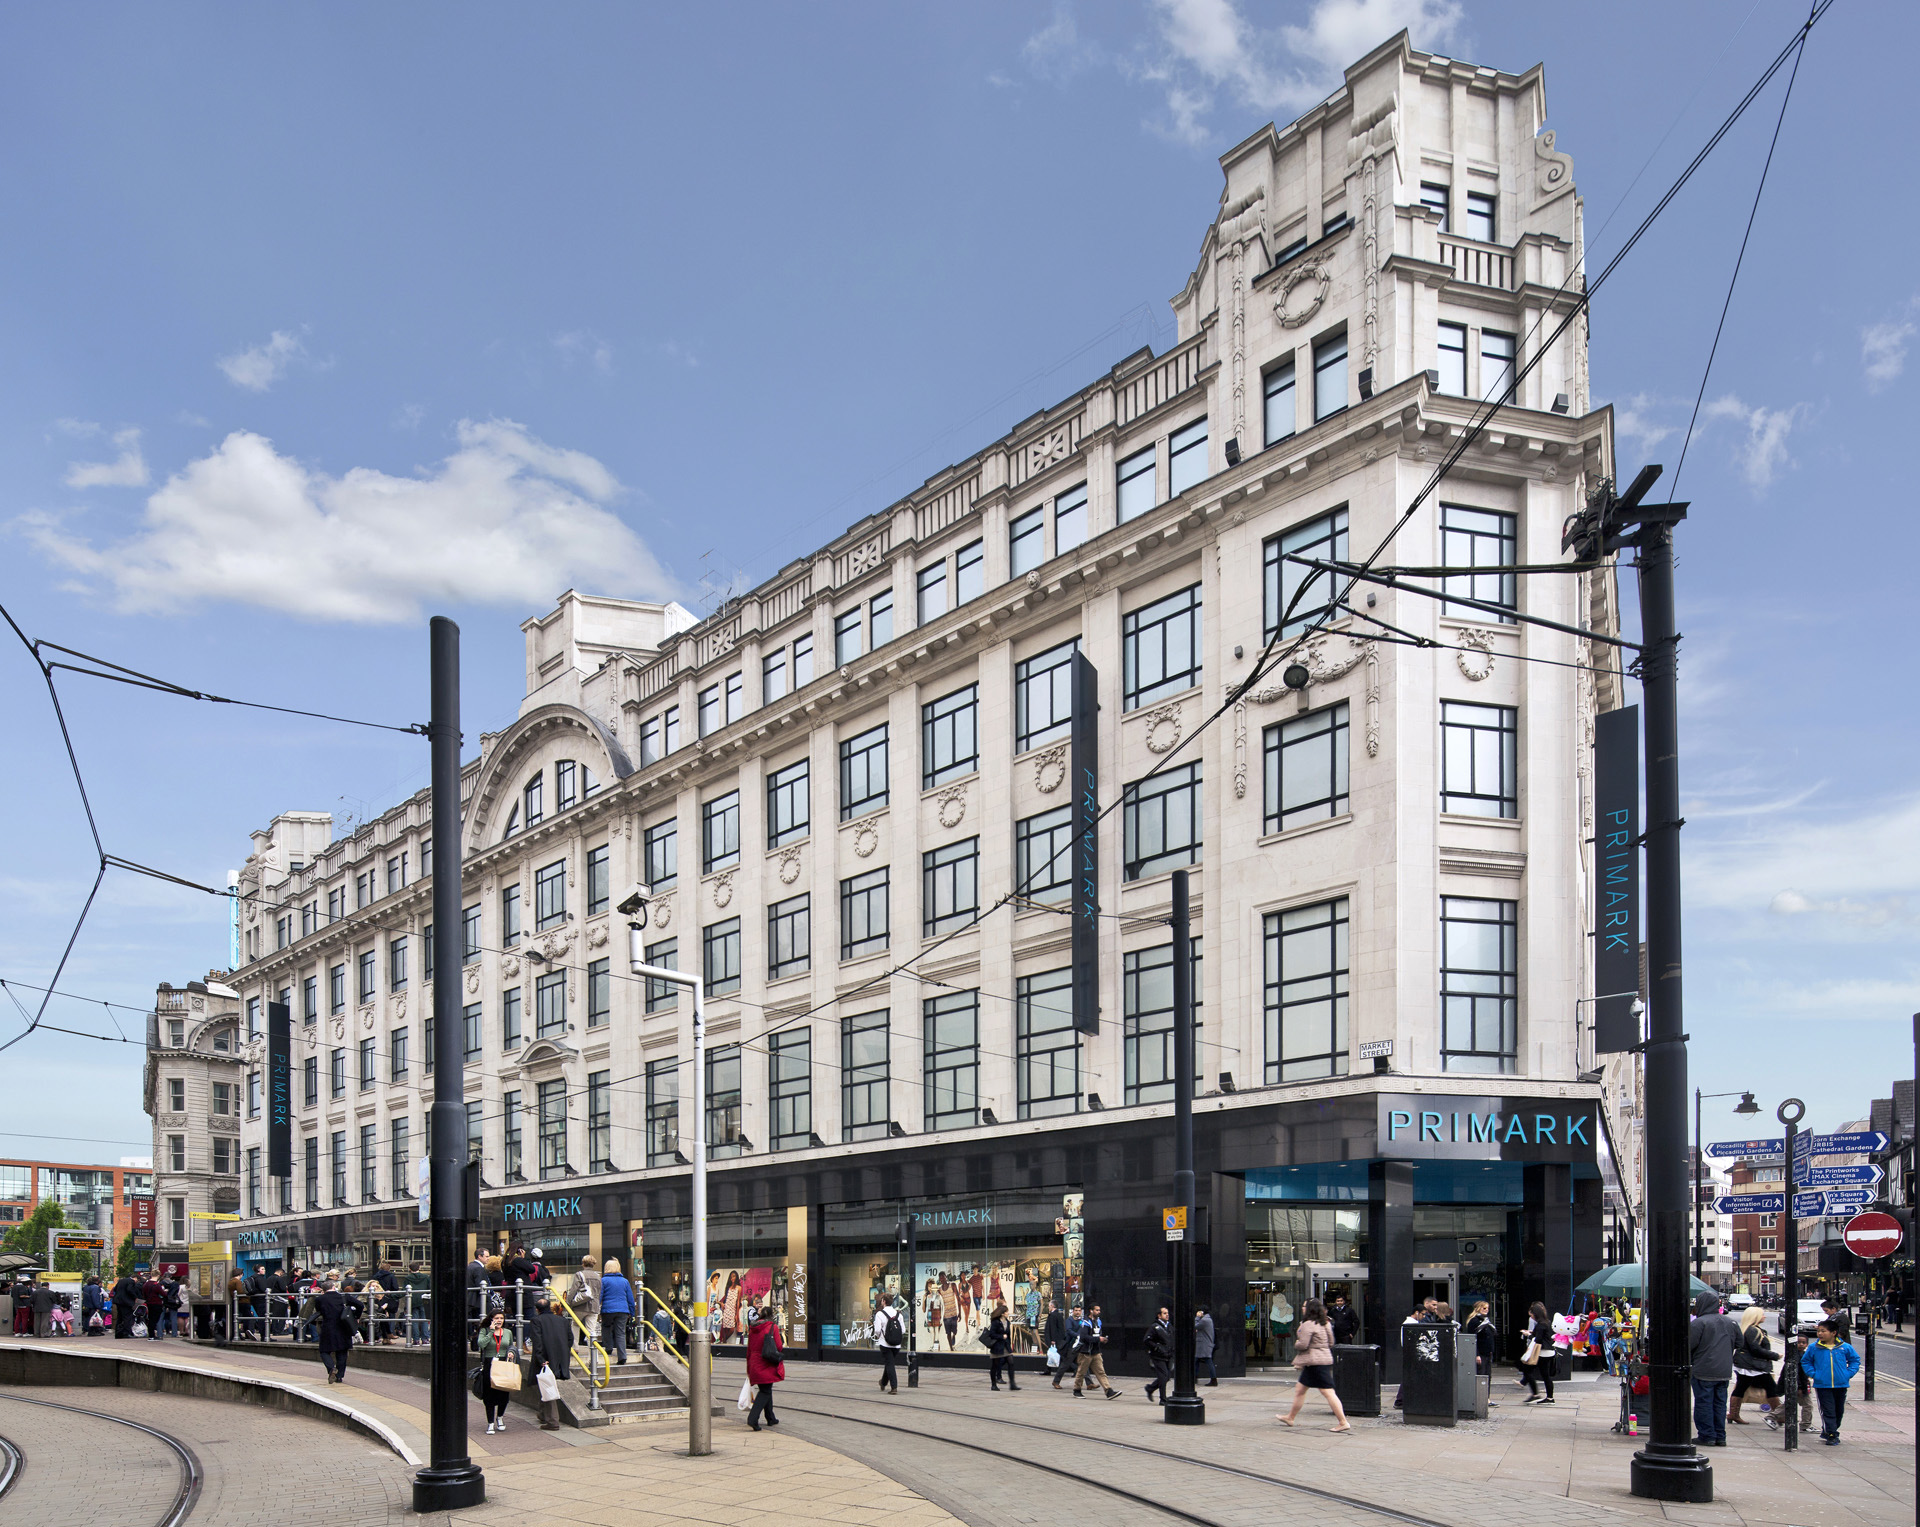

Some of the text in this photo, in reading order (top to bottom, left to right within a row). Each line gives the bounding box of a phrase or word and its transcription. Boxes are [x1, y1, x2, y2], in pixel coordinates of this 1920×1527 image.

[1083, 767, 1095, 920] PRIMARK
[1605, 808, 1629, 951] PRIMARK
[1361, 1041, 1391, 1051] MARKET
[1362, 1048, 1390, 1058] STREET
[274, 1053, 287, 1126] PRIMARK
[1388, 1110, 1589, 1145] PRIMARK
[139, 1201, 149, 1215] LET
[504, 1196, 582, 1222] PRIMARK
[139, 1217, 149, 1228] TO
[911, 1208, 992, 1226] PRIMARK
[238, 1228, 278, 1245] PRIMARK
[541, 1237, 576, 1248] PRIMARK
[925, 1267, 938, 1277] £10
[1001, 1272, 1014, 1282] £10
